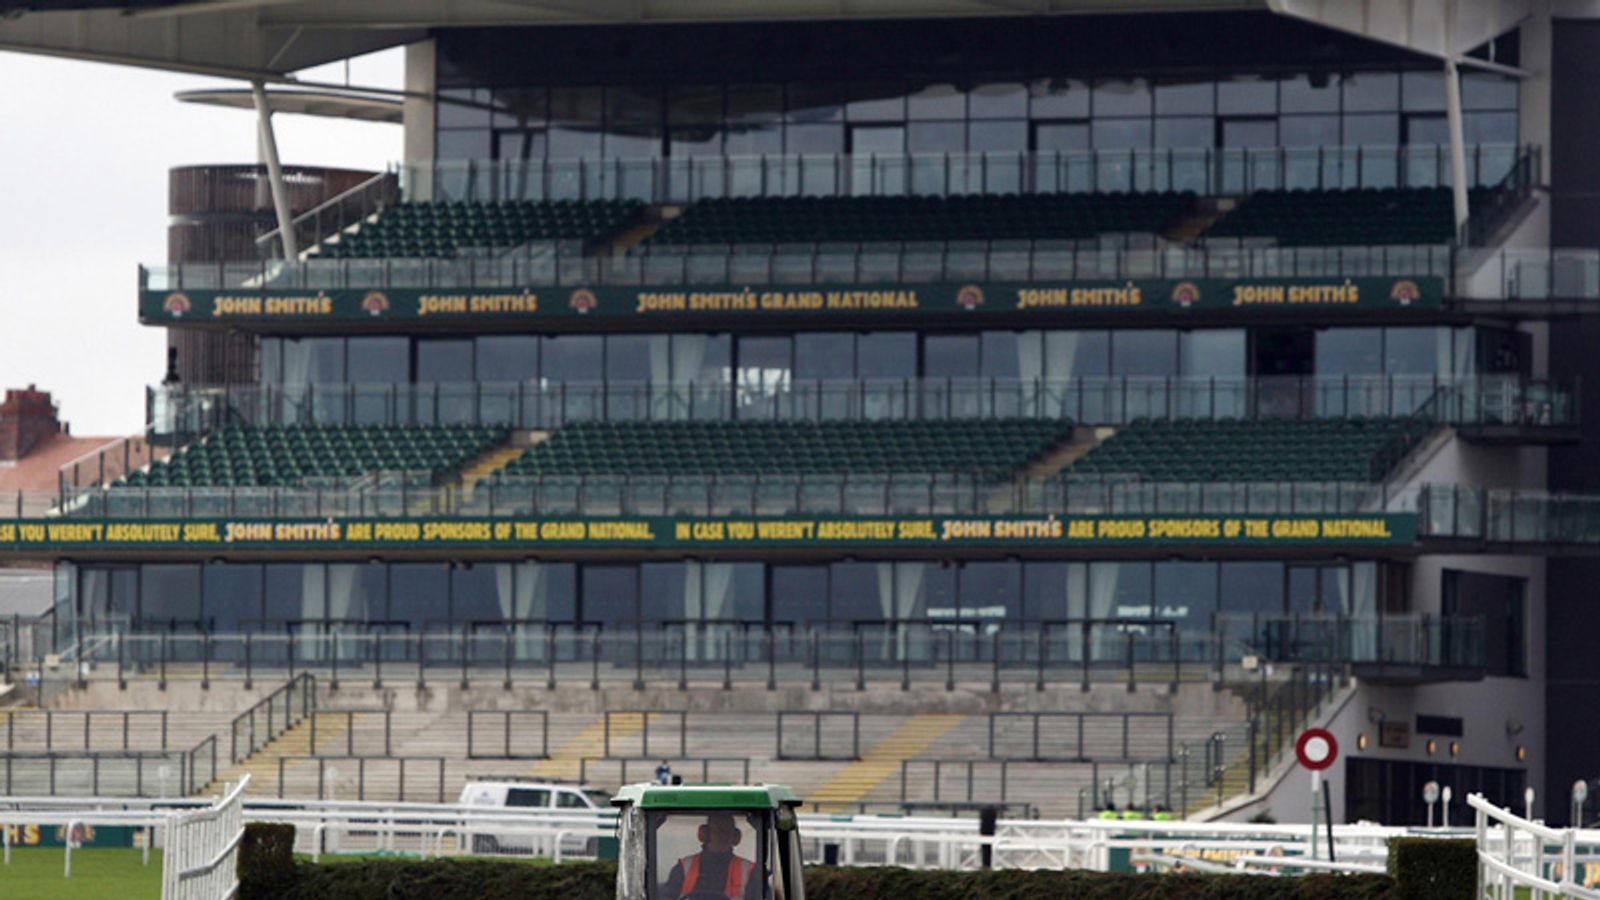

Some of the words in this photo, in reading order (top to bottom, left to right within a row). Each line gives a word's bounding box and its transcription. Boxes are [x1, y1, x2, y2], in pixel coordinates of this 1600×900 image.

[213, 296, 263, 315] JOHN
[265, 290, 332, 313] SMITH'S
[418, 295, 468, 314] JOHN
[470, 289, 538, 312] SMITH'S
[636, 293, 686, 313] JOHN
[689, 287, 755, 310] SMITH'S
[760, 293, 823, 310] GRAND
[827, 291, 918, 308] NATIONAL
[1017, 288, 1067, 308] JOHN
[1070, 281, 1141, 305] SMITH'S
[1232, 286, 1284, 305] JOHN
[1287, 279, 1359, 303] SMITH'S
[19, 524, 44, 541] YOU
[49, 524, 102, 541] WEREN'T
[106, 524, 180, 541] ABSOLUTELY
[183, 524, 221, 541] SURE,
[224, 523, 273, 542] JOHN
[275, 517, 341, 540] SMITH'S
[346, 522, 372, 540] ARE
[375, 522, 420, 540] PROUD
[423, 522, 491, 540] SPONSORS
[495, 522, 511, 540] OF
[515, 522, 538, 540] THE
[541, 522, 586, 540] GRAND
[588, 522, 656, 540] NATIONAL.
[675, 521, 691, 539] IN
[694, 521, 724, 539] CASE
[727, 521, 755, 539] YOU
[758, 521, 814, 539] WEREN'T
[818, 521, 895, 539] ABSOLUTELY
[899, 521, 937, 539] SURE,
[942, 520, 991, 540] JOHN
[994, 514, 1062, 537] SMITH'S
[1068, 520, 1095, 537] ARE
[1099, 520, 1145, 537] PROUD
[1149, 520, 1219, 537] SPONSORS
[1223, 520, 1241, 537] OF
[1245, 520, 1269, 537] THE
[1272, 520, 1319, 537] GRAND
[1322, 520, 1392, 537] NATIONAL.
